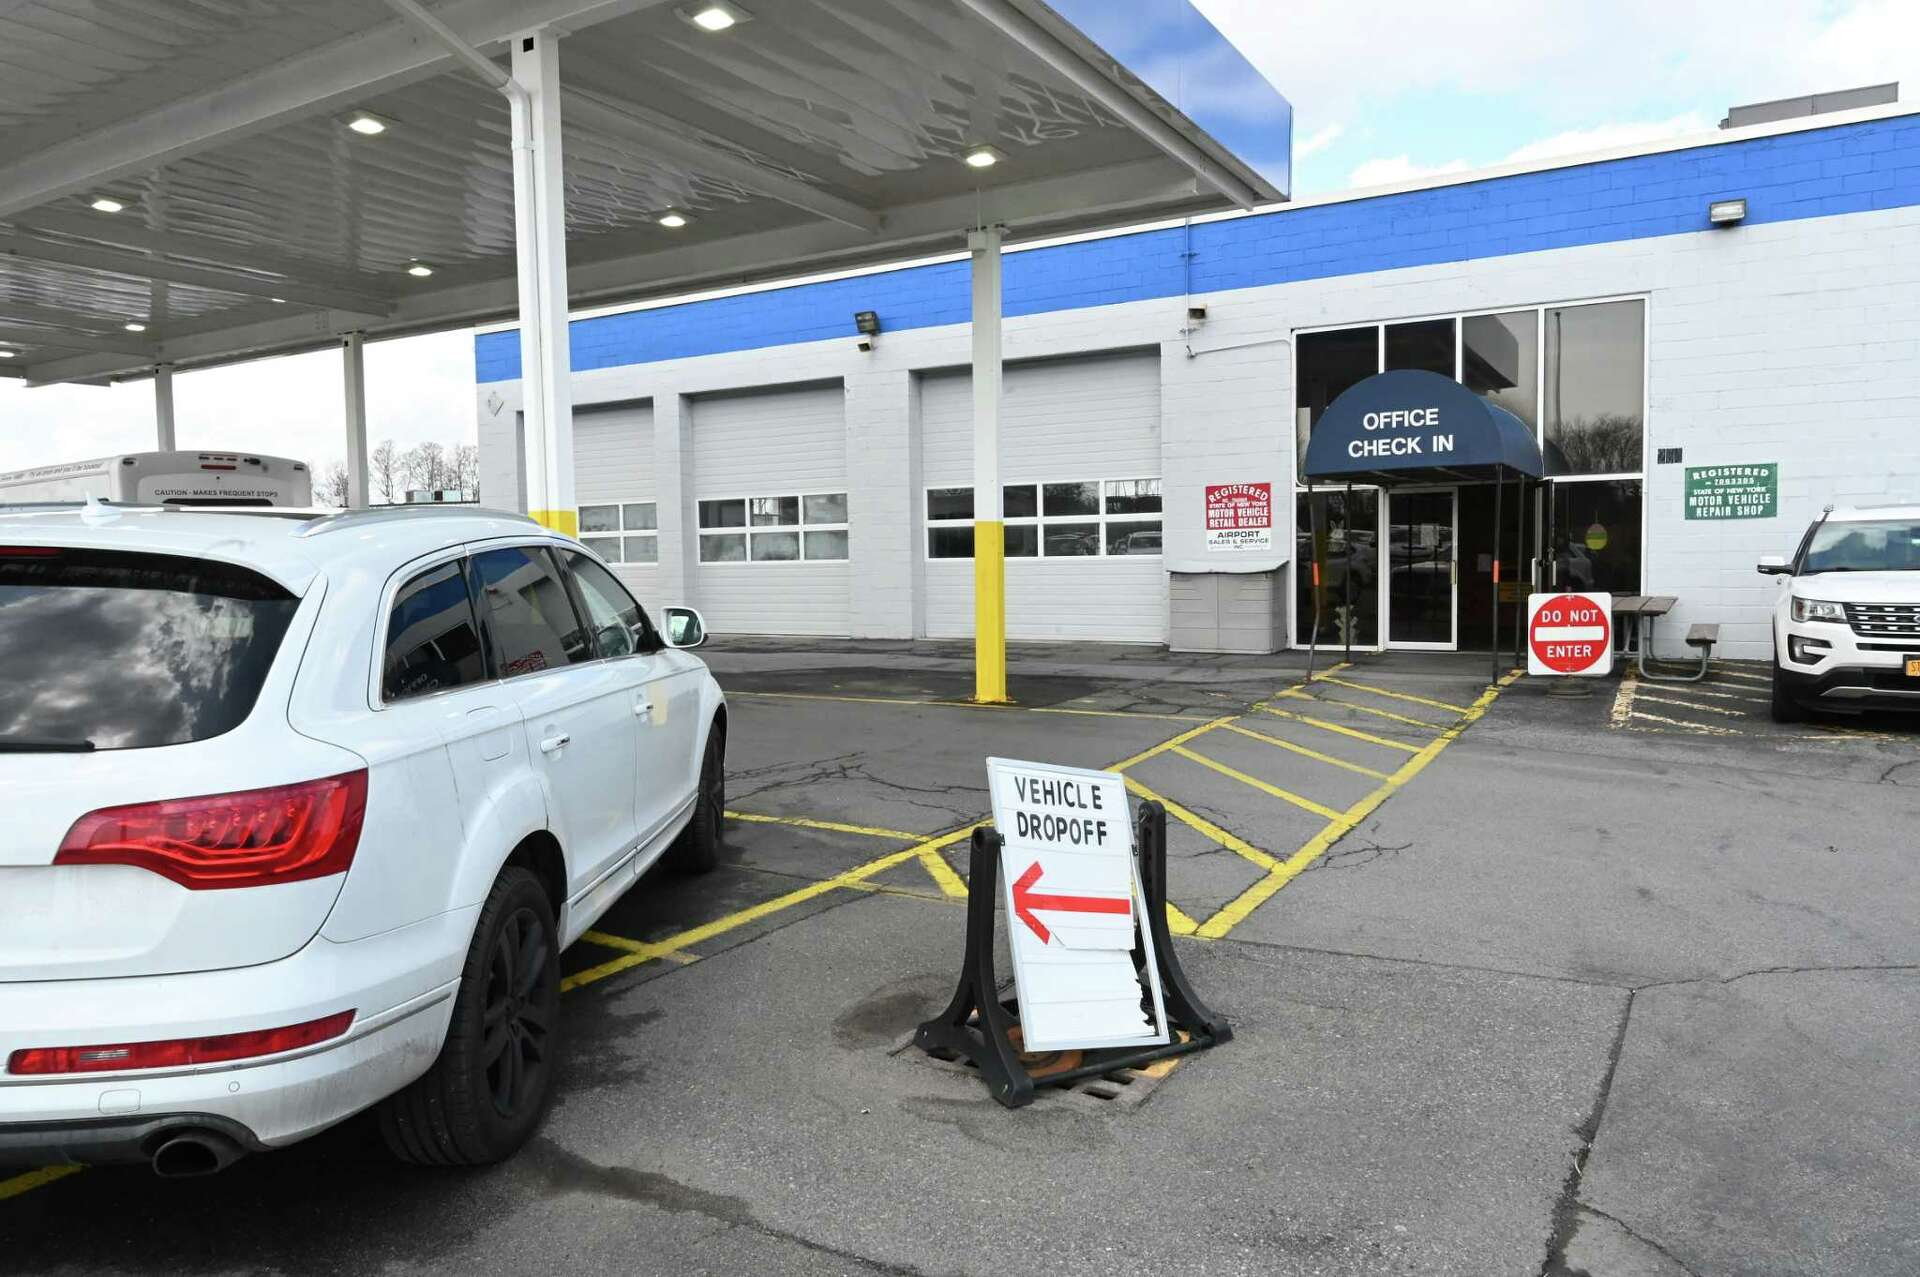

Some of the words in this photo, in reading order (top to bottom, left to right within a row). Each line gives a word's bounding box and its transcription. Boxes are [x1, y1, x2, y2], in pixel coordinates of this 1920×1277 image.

[1363, 408, 1439, 431] OFFICE
[1348, 437, 1422, 458] CHECK
[1432, 434, 1454, 452] IN
[1693, 468, 1769, 480] REGISTERED
[1208, 485, 1269, 503] REGISTERED
[1693, 488, 1712, 496] STATE
[1746, 486, 1767, 494] YORK
[1689, 495, 1722, 507] MOTOR
[1728, 493, 1771, 505] VEHICLE
[1208, 509, 1235, 518] MOTOR
[1237, 507, 1269, 517] VEHICLE
[1696, 507, 1731, 517] REPAIR
[1737, 505, 1764, 516] SHOP
[1209, 519, 1236, 528] RETAIL
[1238, 517, 1268, 527] DEALER
[1541, 610, 1562, 623] DO
[1569, 609, 1598, 622] NOT
[1547, 645, 1592, 658] ENTER
[1014, 775, 1103, 810] VEHICLE
[1016, 811, 1107, 846] DROPOFF
